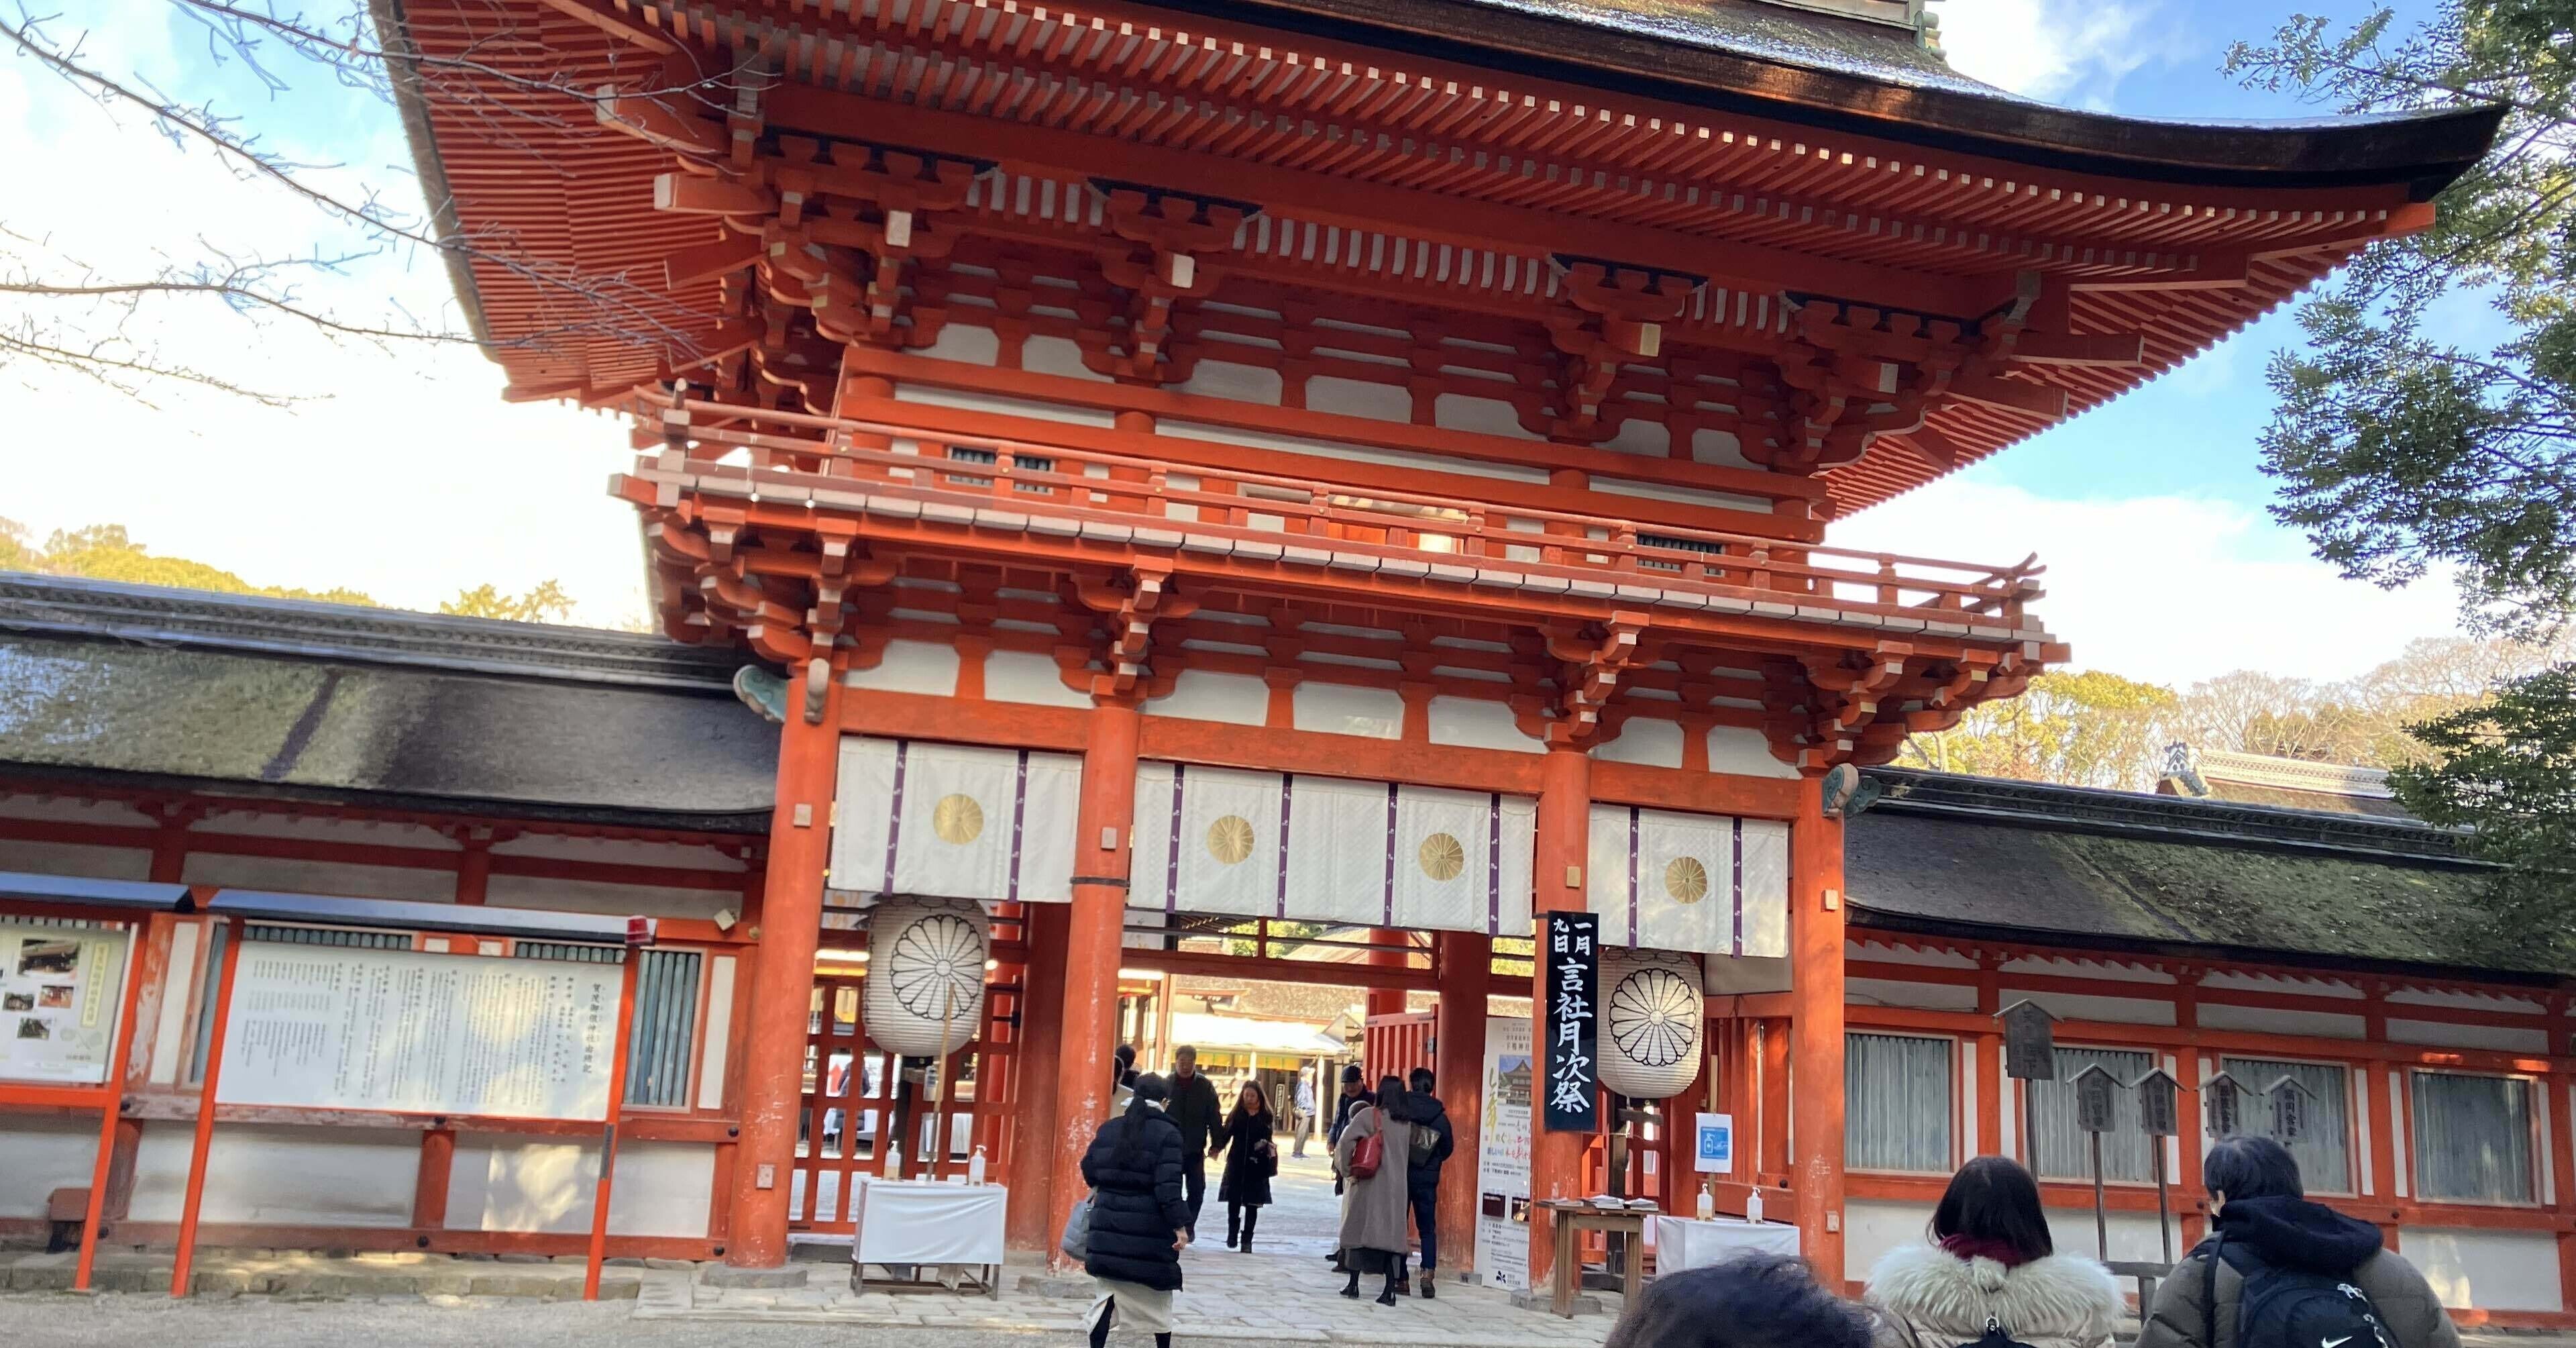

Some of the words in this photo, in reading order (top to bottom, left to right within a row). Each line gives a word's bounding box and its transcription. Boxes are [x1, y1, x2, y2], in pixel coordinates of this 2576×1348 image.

[1553, 918, 1570, 953] 九日
[1574, 921, 1593, 956] 一月
[1550, 957, 1593, 1113] 言社月次祭
